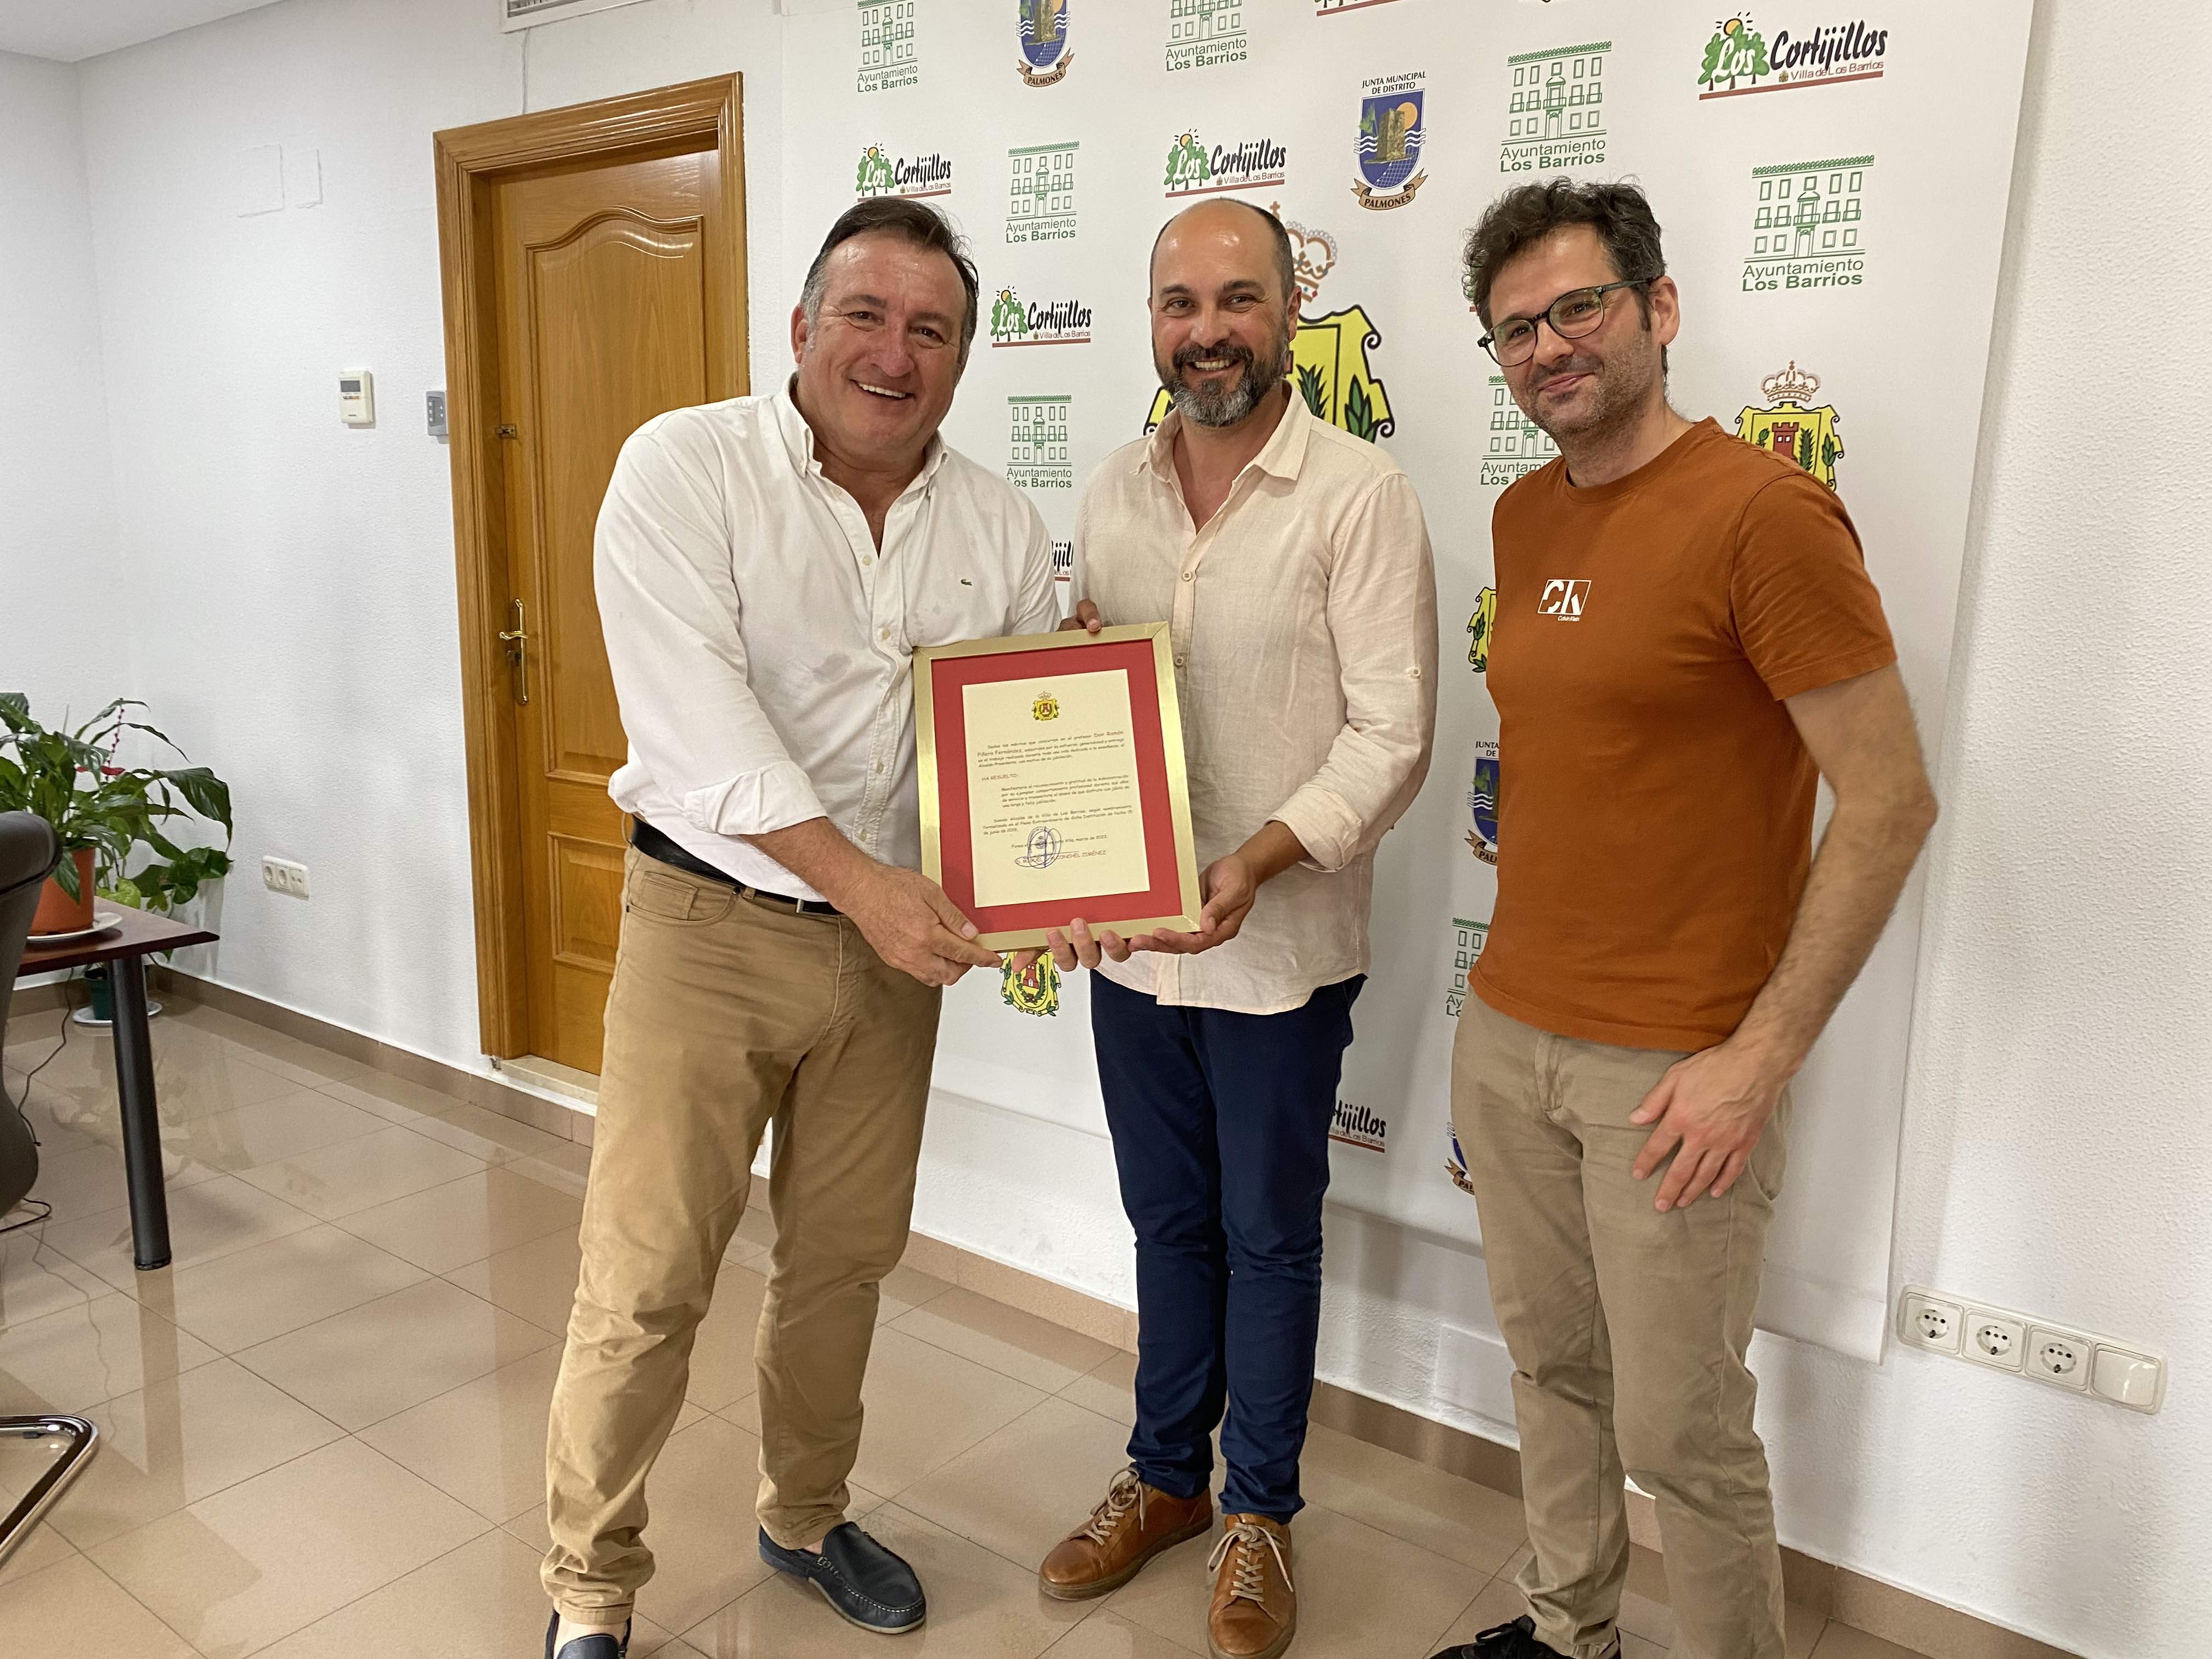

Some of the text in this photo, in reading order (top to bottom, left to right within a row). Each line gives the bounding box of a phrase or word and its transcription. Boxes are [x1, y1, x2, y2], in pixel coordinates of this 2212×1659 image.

[1166, 38, 1246, 61] Ayuntamiento
[1712, 19, 1888, 77] Los Cortijillos
[1166, 51, 1247, 71] Los Barrios
[857, 65, 917, 84] Ayuntamiento
[1028, 70, 1062, 84] PALMONES
[1362, 71, 1426, 88] JUNTA MUNICIPAL
[1792, 70, 1813, 81] Villa
[1849, 61, 1884, 72] Barrios
[857, 76, 917, 92] Los Barrios
[1383, 82, 1415, 92] DISTRITO
[1500, 138, 1605, 161] Ayuntamiento
[1173, 138, 1286, 180] Los Cortijillos
[1500, 153, 1605, 172] Los Barrios
[862, 153, 951, 188] Los Cortijillos
[1364, 193, 1410, 207] PALMONES
[1006, 218, 1076, 234] Ayuntamiento
[1006, 229, 1075, 243] Los Barrios
[1742, 258, 1864, 280] Ayuntamiento
[1742, 273, 1863, 291] Los Barrios
[997, 300, 1092, 334] Los Cortijillos
[1007, 467, 1072, 479] Ayuntamiento
[1481, 474, 1509, 485] Los
[1007, 478, 1072, 488] os Barrios
[1475, 741, 1499, 749] JUNTA
